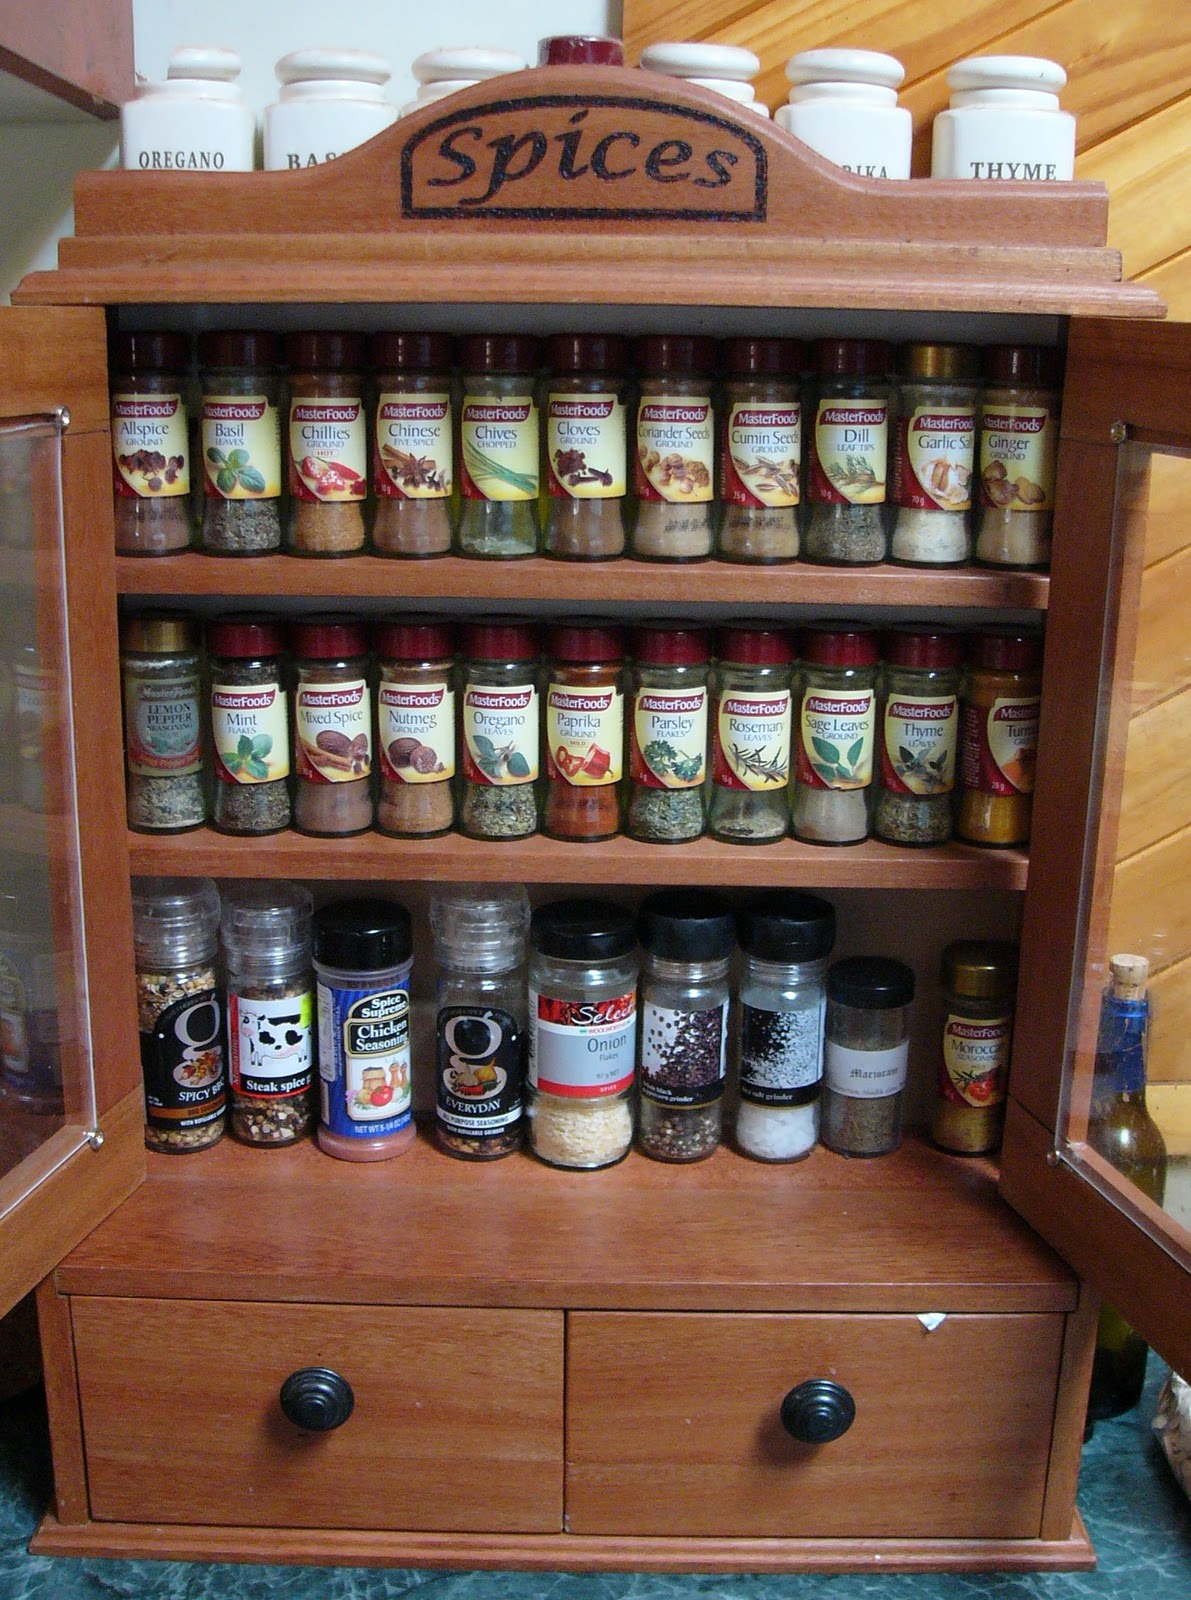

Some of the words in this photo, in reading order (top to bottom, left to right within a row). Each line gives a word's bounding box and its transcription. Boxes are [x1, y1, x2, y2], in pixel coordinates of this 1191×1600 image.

[139, 151, 225, 169] OREGANO
[287, 152, 343, 170] BAS
[427, 110, 738, 206] Spices
[970, 162, 1057, 180] THYME
[296, 407, 356, 420] MasterFoods
[384, 405, 445, 418] MasterFoods
[467, 407, 527, 421] MasterFoods
[644, 407, 705, 420] MasterFoods
[738, 412, 798, 425] MasterFoods
[825, 411, 885, 423] MasterFoods
[120, 422, 169, 438] Allspice
[215, 423, 244, 437] Basil
[302, 425, 350, 440] Chillies
[389, 423, 441, 437] Chinese
[475, 426, 518, 441] Chives
[557, 421, 600, 436] Cloves
[732, 430, 769, 444] Cumin
[844, 429, 869, 443] Dill
[918, 435, 956, 450] Garlic
[988, 435, 1029, 452] Ginger
[214, 693, 272, 707] MasterFoods
[302, 691, 362, 705] MasterFoods
[382, 692, 440, 706] MasterFoods
[469, 693, 528, 707] MasterFoods
[551, 696, 609, 709] MasterFoods
[643, 698, 702, 711] MasterFoods
[810, 698, 869, 711] MasterFoods
[148, 703, 192, 715] LEMON
[728, 701, 786, 714] MasterFoods
[893, 704, 952, 718] MasterFoods
[147, 713, 192, 725] PEPPER
[227, 713, 257, 726] Mint
[300, 710, 332, 724] Mixed
[333, 709, 363, 728] Spice
[389, 710, 437, 729] Nutmeg
[473, 711, 525, 729] Oregano
[557, 713, 601, 729] Paprika
[651, 716, 695, 734] Parsley
[805, 716, 831, 734] Sage
[834, 718, 869, 731] Leaves
[729, 718, 785, 736] Rosemary
[903, 723, 944, 739] Thyme
[361, 1000, 407, 1018] Supreme
[371, 995, 402, 1009] Spice
[571, 1004, 633, 1024] Select
[358, 1019, 408, 1038] Chicken
[587, 1034, 627, 1052] Onion
[600, 1053, 619, 1062] Flakes
[246, 1079, 279, 1093] Steak
[281, 1077, 306, 1092] spice
[178, 1089, 211, 1102] SPICY
[446, 1096, 501, 1113] EVERYDAY
[354, 1125, 367, 1134] NET
